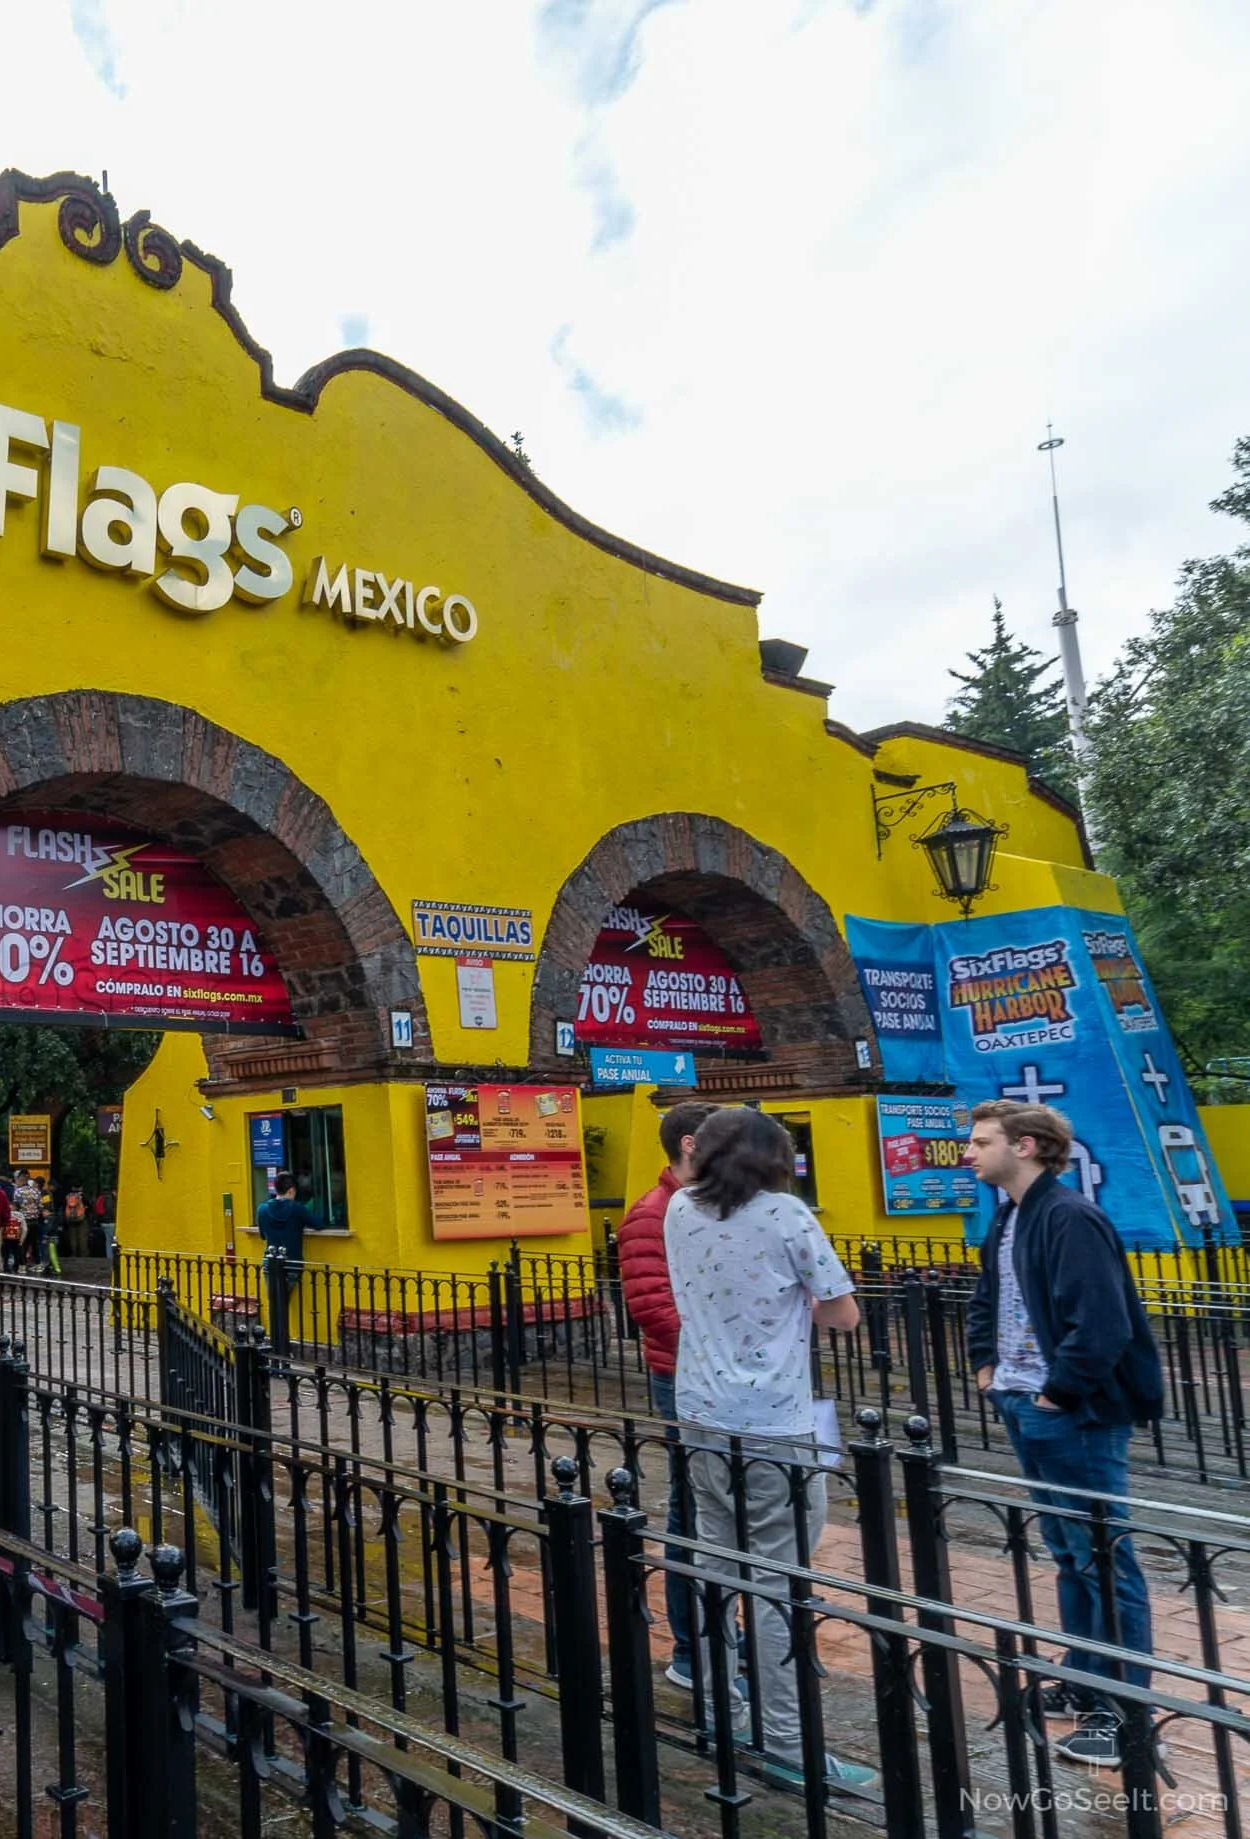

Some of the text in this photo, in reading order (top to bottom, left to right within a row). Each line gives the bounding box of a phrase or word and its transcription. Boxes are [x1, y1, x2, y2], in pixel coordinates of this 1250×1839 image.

[306, 555, 478, 644] MEXICO
[7, 826, 91, 864] FLASH
[103, 870, 165, 903] SALE
[98, 916, 257, 953] AGOSTO 30 A
[416, 912, 531, 945] TAQUILLAS
[91, 941, 264, 977] SEPTIEMBRE 16
[649, 935, 684, 960] SALE
[583, 964, 632, 985] HORRA
[647, 970, 740, 995] AGOSTO 30 A
[864, 968, 933, 990] TRANSPORTE
[953, 965, 1072, 1004] HURRICANE
[96, 979, 263, 1003] CÓMPRALO EN sixflags.com.mx
[643, 989, 745, 1014] SEPTIEMBRE 16
[880, 991, 926, 1010] SOCIOS
[578, 985, 636, 1024] 70%
[975, 990, 1067, 1032] HARBOR
[395, 1018, 411, 1041] 11
[689, 1021, 698, 1031] EN
[873, 1011, 901, 1030] PASE
[975, 1025, 1073, 1052] OAXTEPEC
[605, 1054, 642, 1065] ACTIVA TU
[597, 1067, 651, 1081] PASE ANUAL
[428, 1094, 448, 1106] 70%
[881, 1104, 950, 1116] TRANSPORTE SOCIOS
[907, 1118, 923, 1128] PASE
